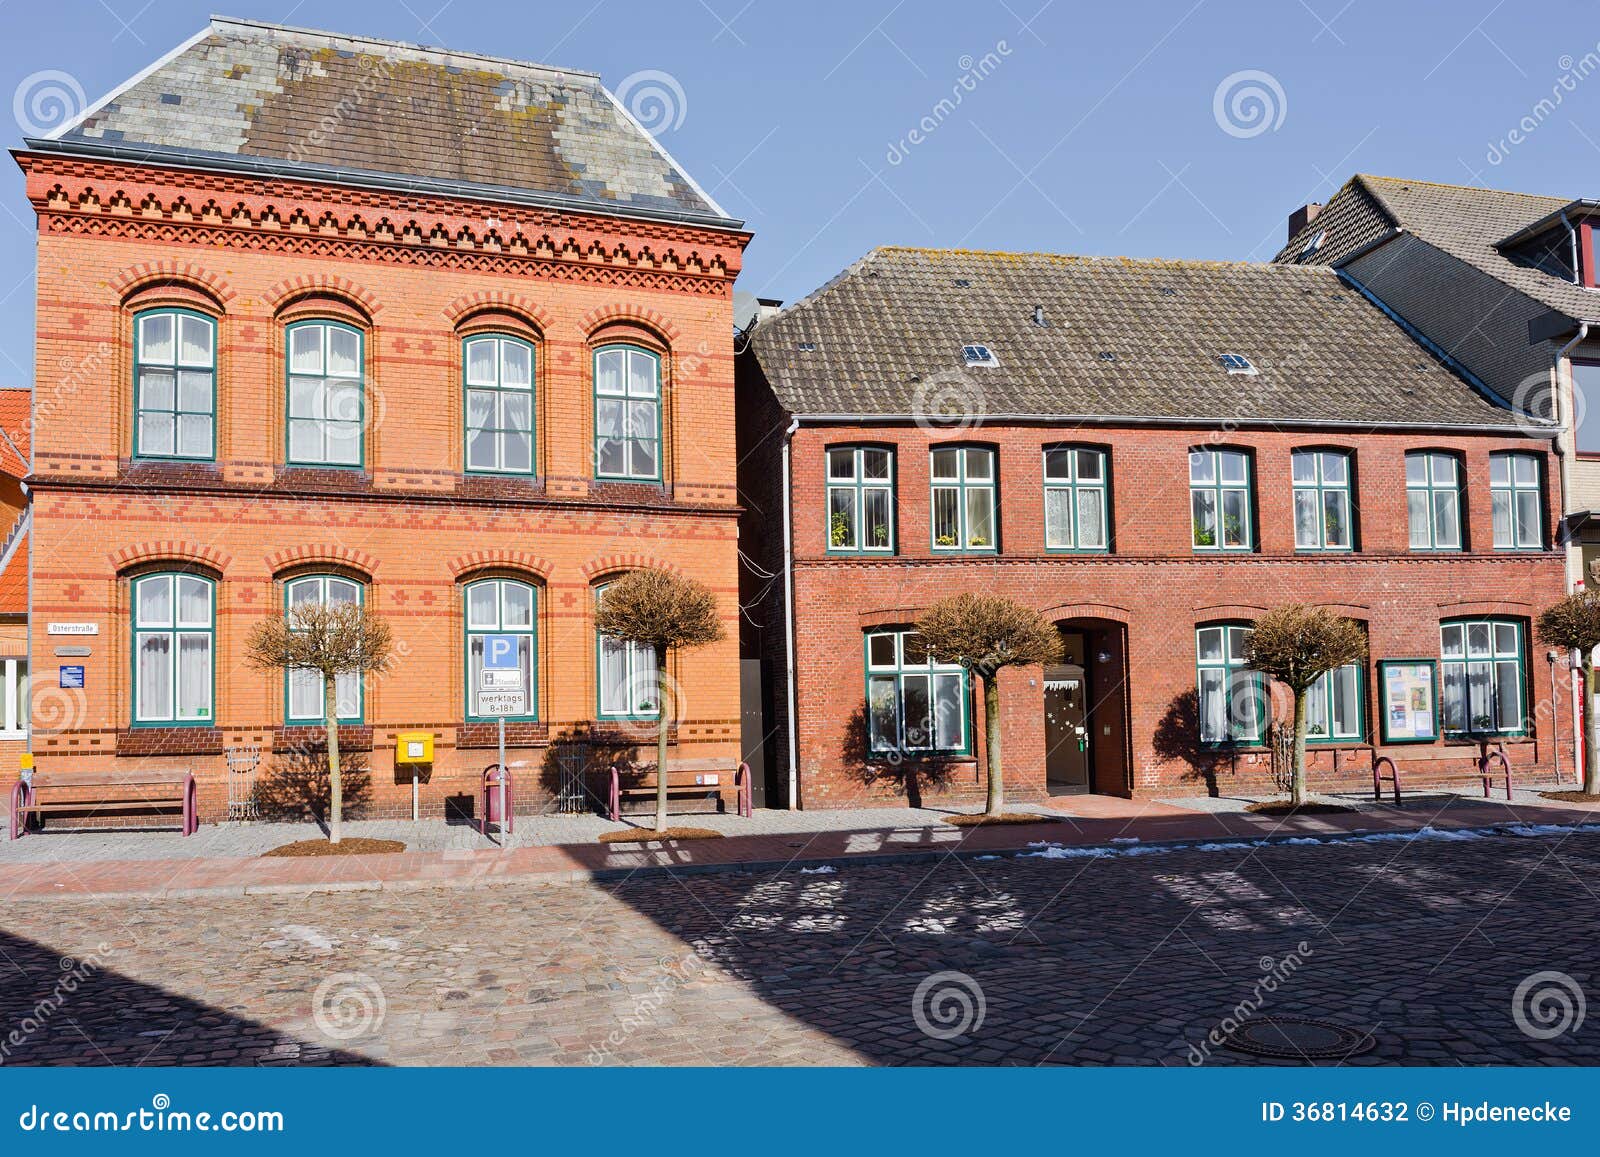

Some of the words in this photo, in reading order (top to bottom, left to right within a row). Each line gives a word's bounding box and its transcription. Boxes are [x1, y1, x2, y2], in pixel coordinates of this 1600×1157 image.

[52, 624, 94, 632] Osterstraße
[492, 639, 511, 664] P
[481, 695, 522, 703] werktags
[489, 704, 514, 712] 8-18h
